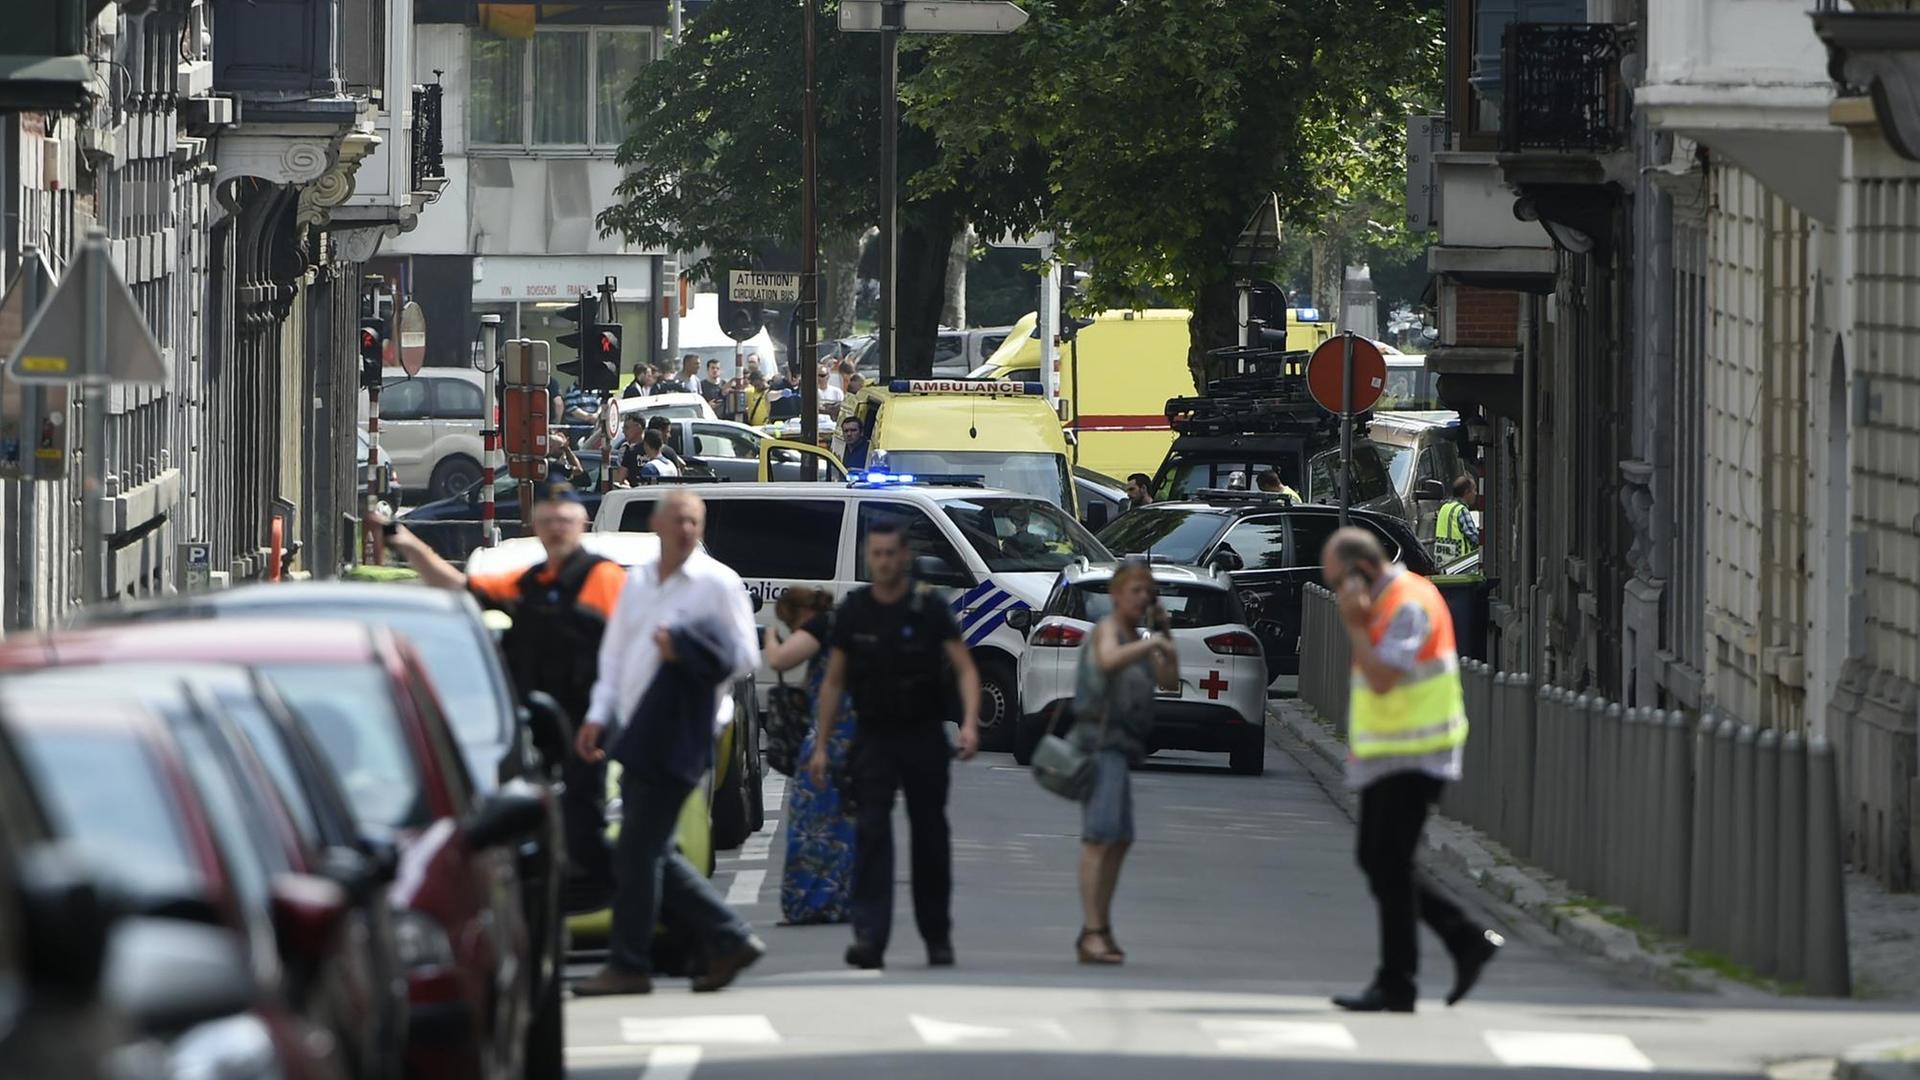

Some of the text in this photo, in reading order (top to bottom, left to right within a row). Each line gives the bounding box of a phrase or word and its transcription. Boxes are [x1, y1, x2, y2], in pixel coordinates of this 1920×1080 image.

[736, 273, 793, 287] ATTENTION!
[526, 284, 557, 296] BOISSONS
[733, 288, 795, 301] CIRCULATION BUS
[912, 382, 1023, 393] AMBULANCE
[189, 547, 206, 562] P
